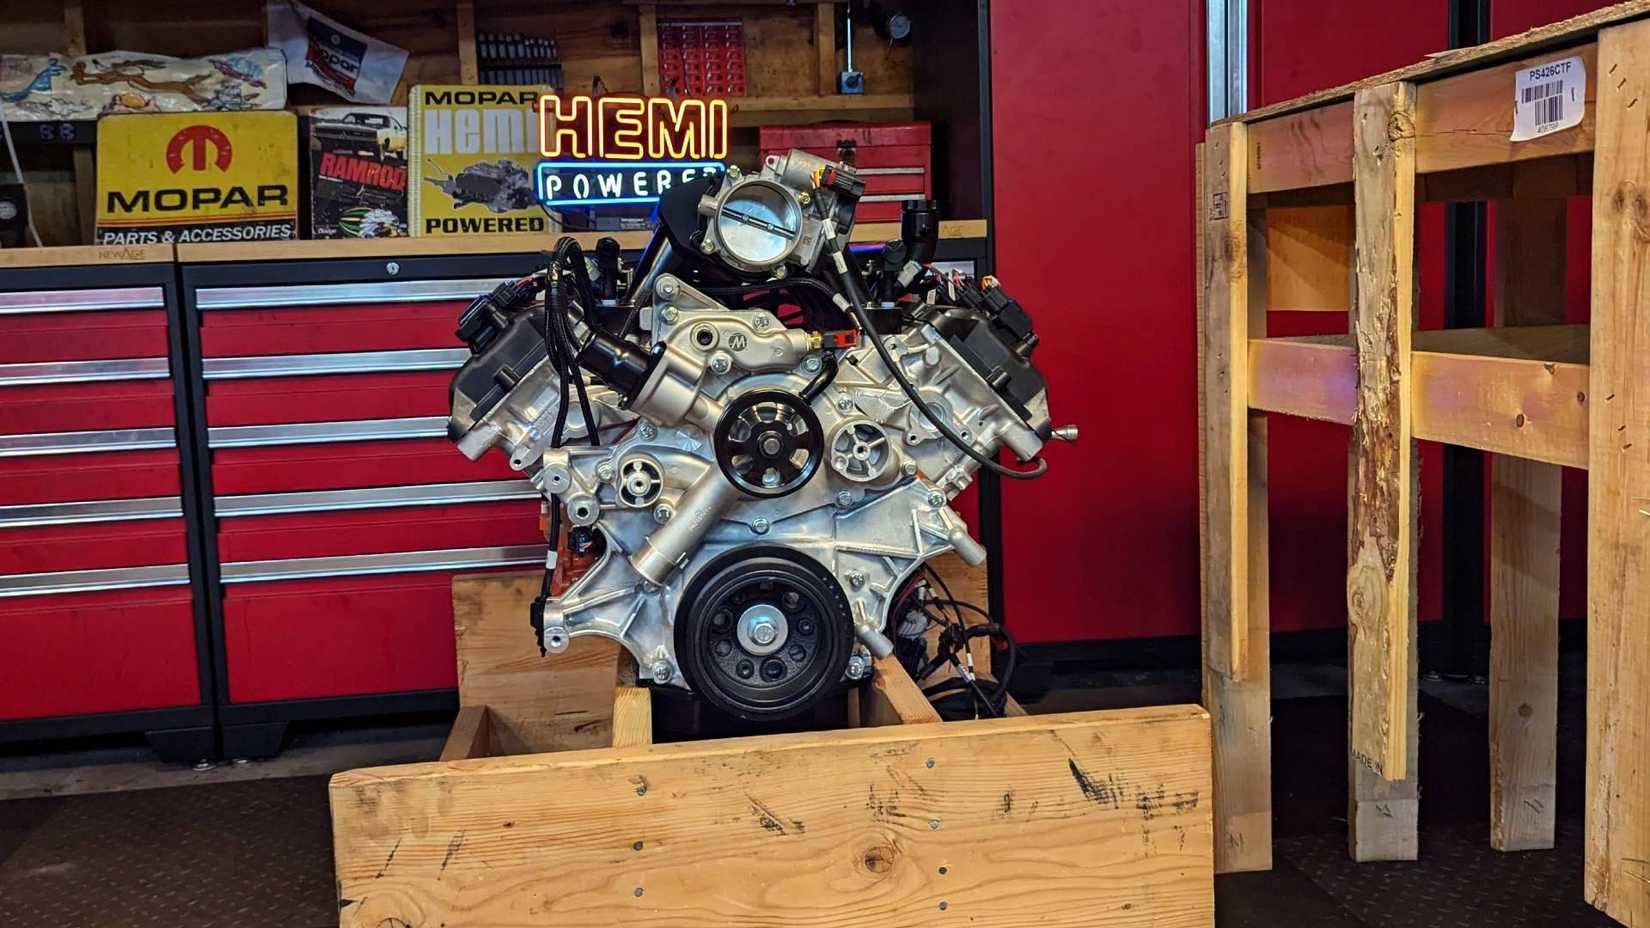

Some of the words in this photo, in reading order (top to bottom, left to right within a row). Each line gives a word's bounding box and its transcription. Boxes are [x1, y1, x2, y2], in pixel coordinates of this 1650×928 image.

[1529, 61, 1572, 81] PS426CTF
[425, 91, 538, 105] MOPAR
[540, 95, 728, 160] HEMI
[319, 152, 407, 192] RAMROD
[107, 184, 289, 213] MOPAR
[103, 231, 158, 245] PARTS
[161, 231, 175, 244] &
[179, 224, 291, 242] ACCESSORIES
[426, 217, 544, 233] POWERED
